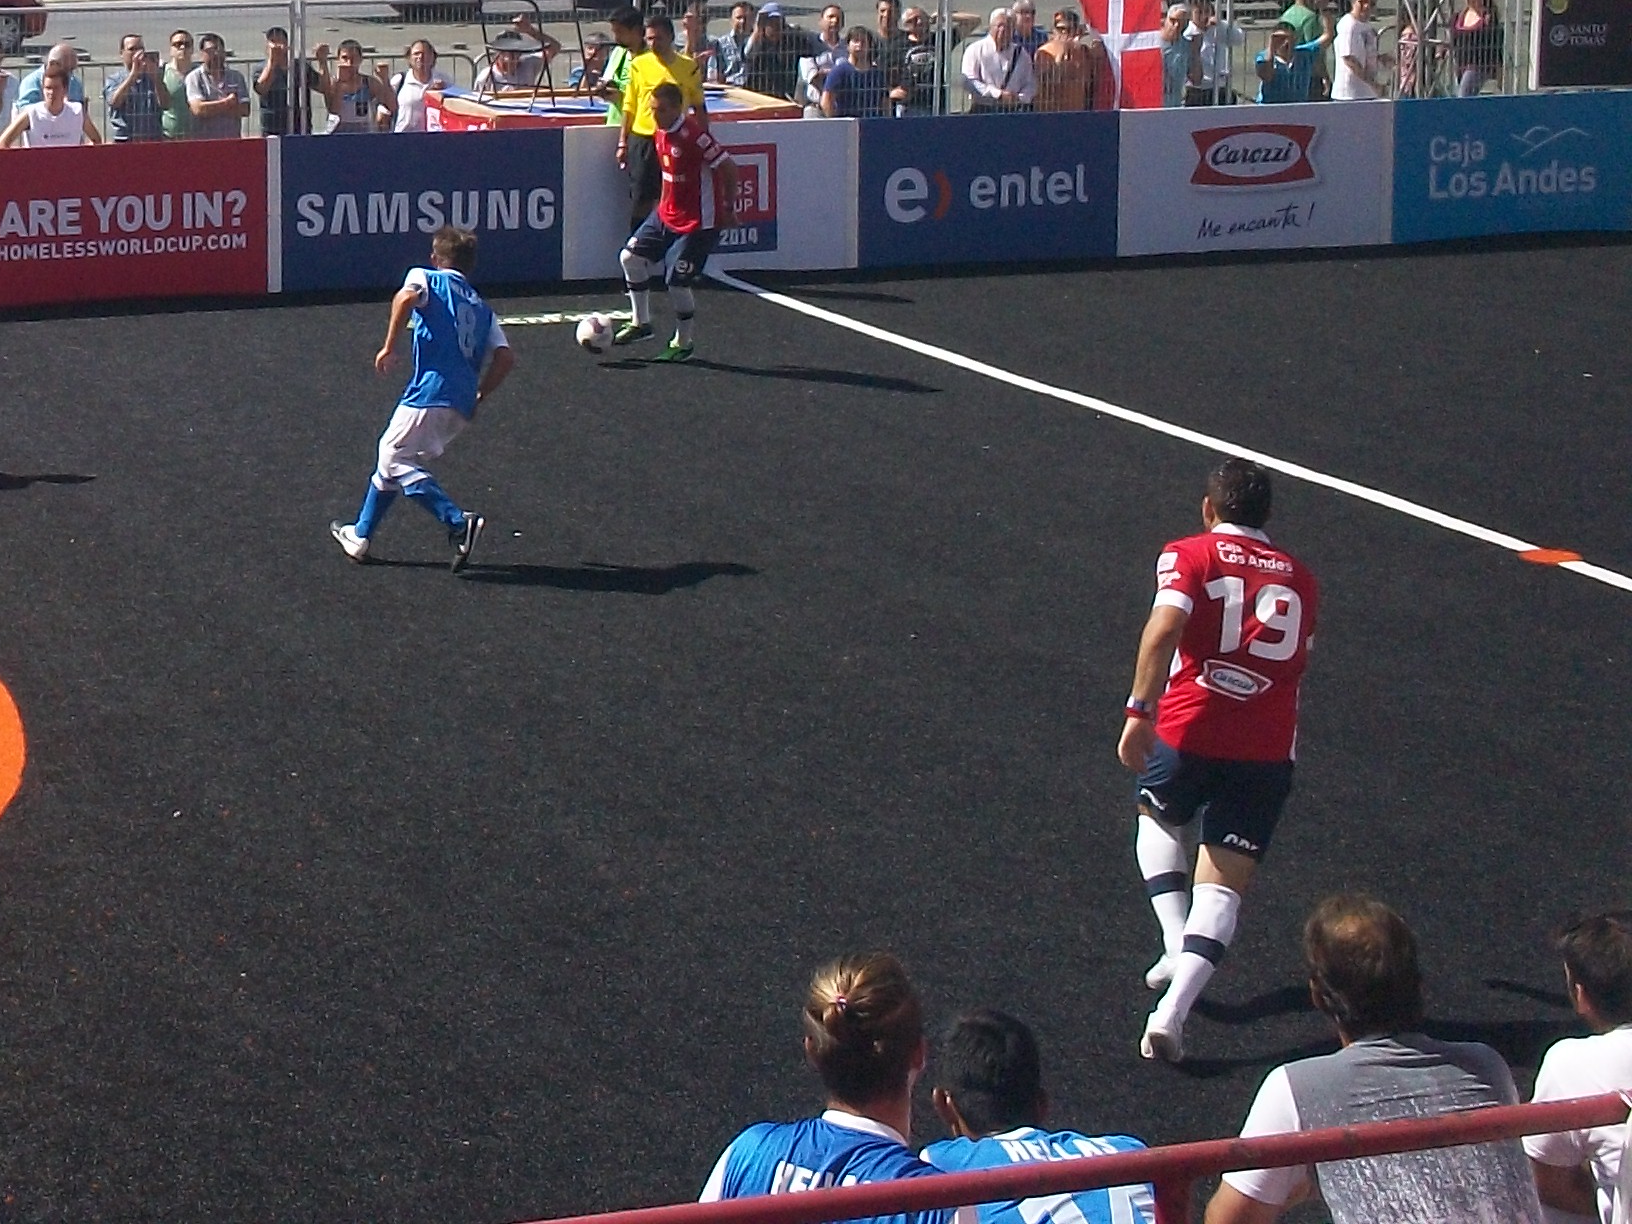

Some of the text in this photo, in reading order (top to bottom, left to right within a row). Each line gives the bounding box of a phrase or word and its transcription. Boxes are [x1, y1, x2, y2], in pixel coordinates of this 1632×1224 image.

[1210, 140, 1297, 167] Carozzi
[1429, 133, 1485, 167] Caja
[968, 163, 1090, 211] entel
[1429, 158, 1599, 199] Los Andes
[90, 193, 173, 234] YOU
[183, 189, 248, 228] IN?
[296, 187, 556, 237] SAMSUNG
[1196, 216, 1223, 240] Me
[719, 227, 759, 247] 2014
[1216, 541, 1243, 555] Caja
[1218, 551, 1294, 573] Los Andes
[1205, 576, 1302, 662] 19
[770, 1160, 872, 1196] HELL
